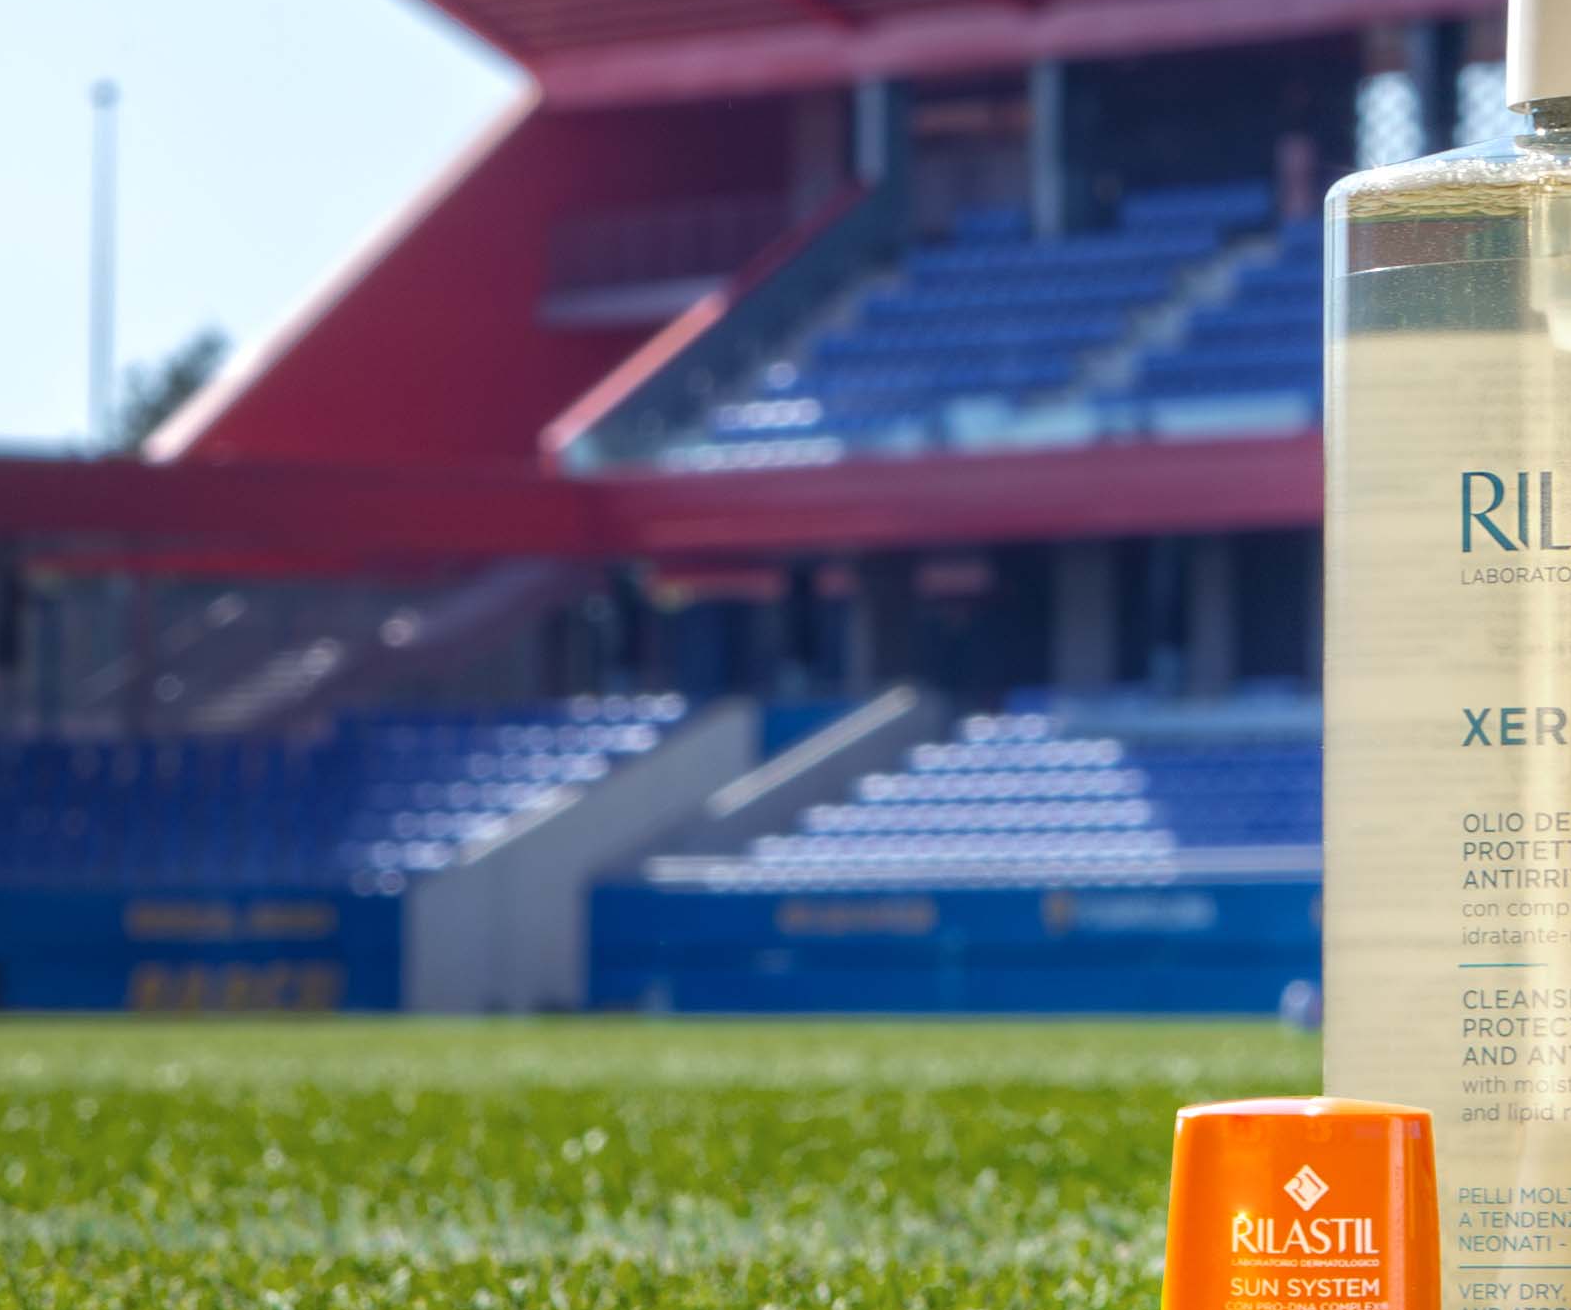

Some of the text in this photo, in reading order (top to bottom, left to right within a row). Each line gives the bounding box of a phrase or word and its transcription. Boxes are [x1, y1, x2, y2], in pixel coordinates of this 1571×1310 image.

[1463, 812, 1524, 833] OLIO
[1462, 902, 1499, 917] con
[1463, 1046, 1517, 1066] AND
[1462, 1076, 1506, 1093] with
[1462, 1104, 1499, 1121] and
[1508, 1103, 1554, 1124] lipid
[1459, 1187, 1512, 1204] PELLI
[1459, 1212, 1473, 1228] A
[1231, 1217, 1379, 1254] RILASTIL
[1459, 1236, 1552, 1252] NEONATI
[1300, 1259, 1379, 1267] DERMATOLOGICO
[1230, 1277, 1380, 1297] SUN SYSTEM
[1459, 1284, 1511, 1300] VERY
[1520, 1284, 1567, 1302] DRY,
